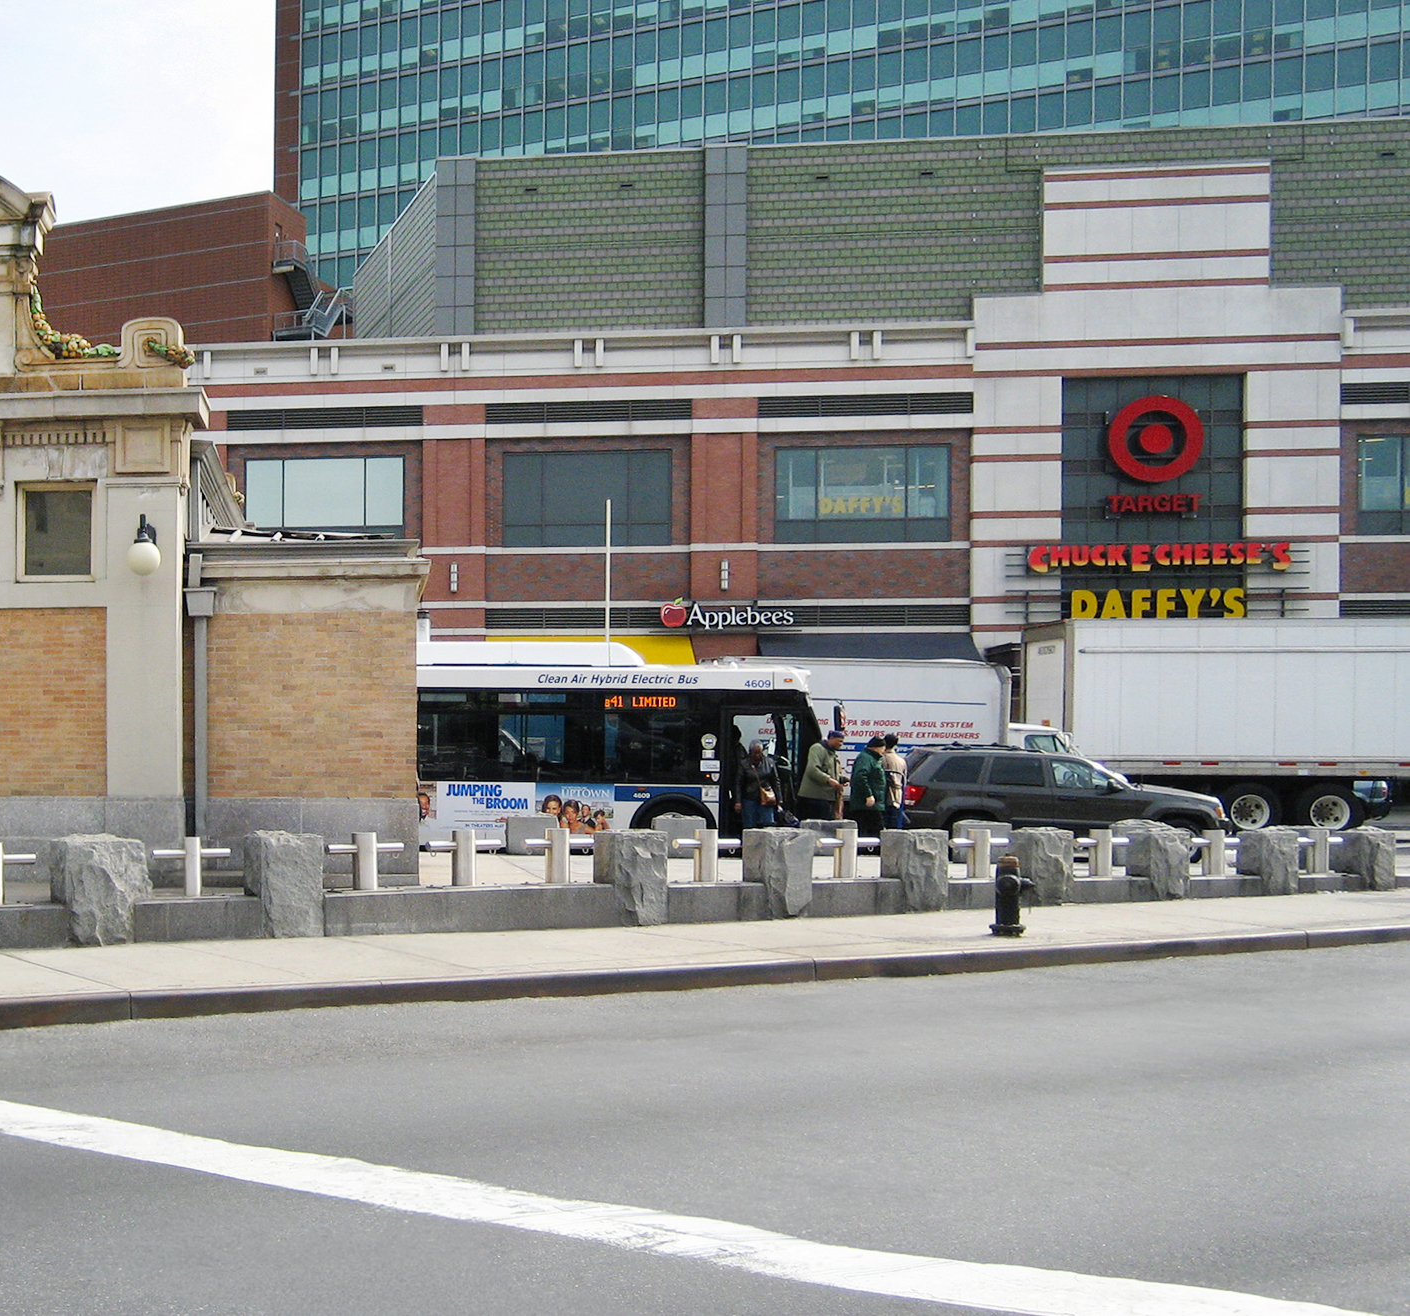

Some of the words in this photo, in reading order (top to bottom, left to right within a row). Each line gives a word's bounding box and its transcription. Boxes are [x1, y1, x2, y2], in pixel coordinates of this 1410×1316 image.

[819, 495, 904, 515] DAFFY'S
[1105, 493, 1203, 513] TARGET
[1027, 544, 1128, 573] CHUCK
[1131, 544, 1153, 572] E
[1153, 541, 1292, 571] CHEESE'S
[1071, 587, 1245, 619] DAFFY'S
[686, 603, 794, 630] Applebee's
[537, 674, 569, 685] Clean
[570, 674, 588, 684] Air
[590, 674, 628, 687] Hybrid
[631, 674, 674, 685] Electric
[677, 674, 699, 685] Bus
[744, 679, 771, 689] 4609
[632, 696, 676, 708] LIMITED
[873, 719, 901, 727] HOODS
[911, 720, 937, 728] ANSUL
[916, 732, 981, 740] EXTINGUISHERS
[445, 784, 503, 797] JUMPING
[561, 788, 610, 798] UPTOWN
[472, 797, 485, 805] THE
[485, 797, 529, 810] BROOM
